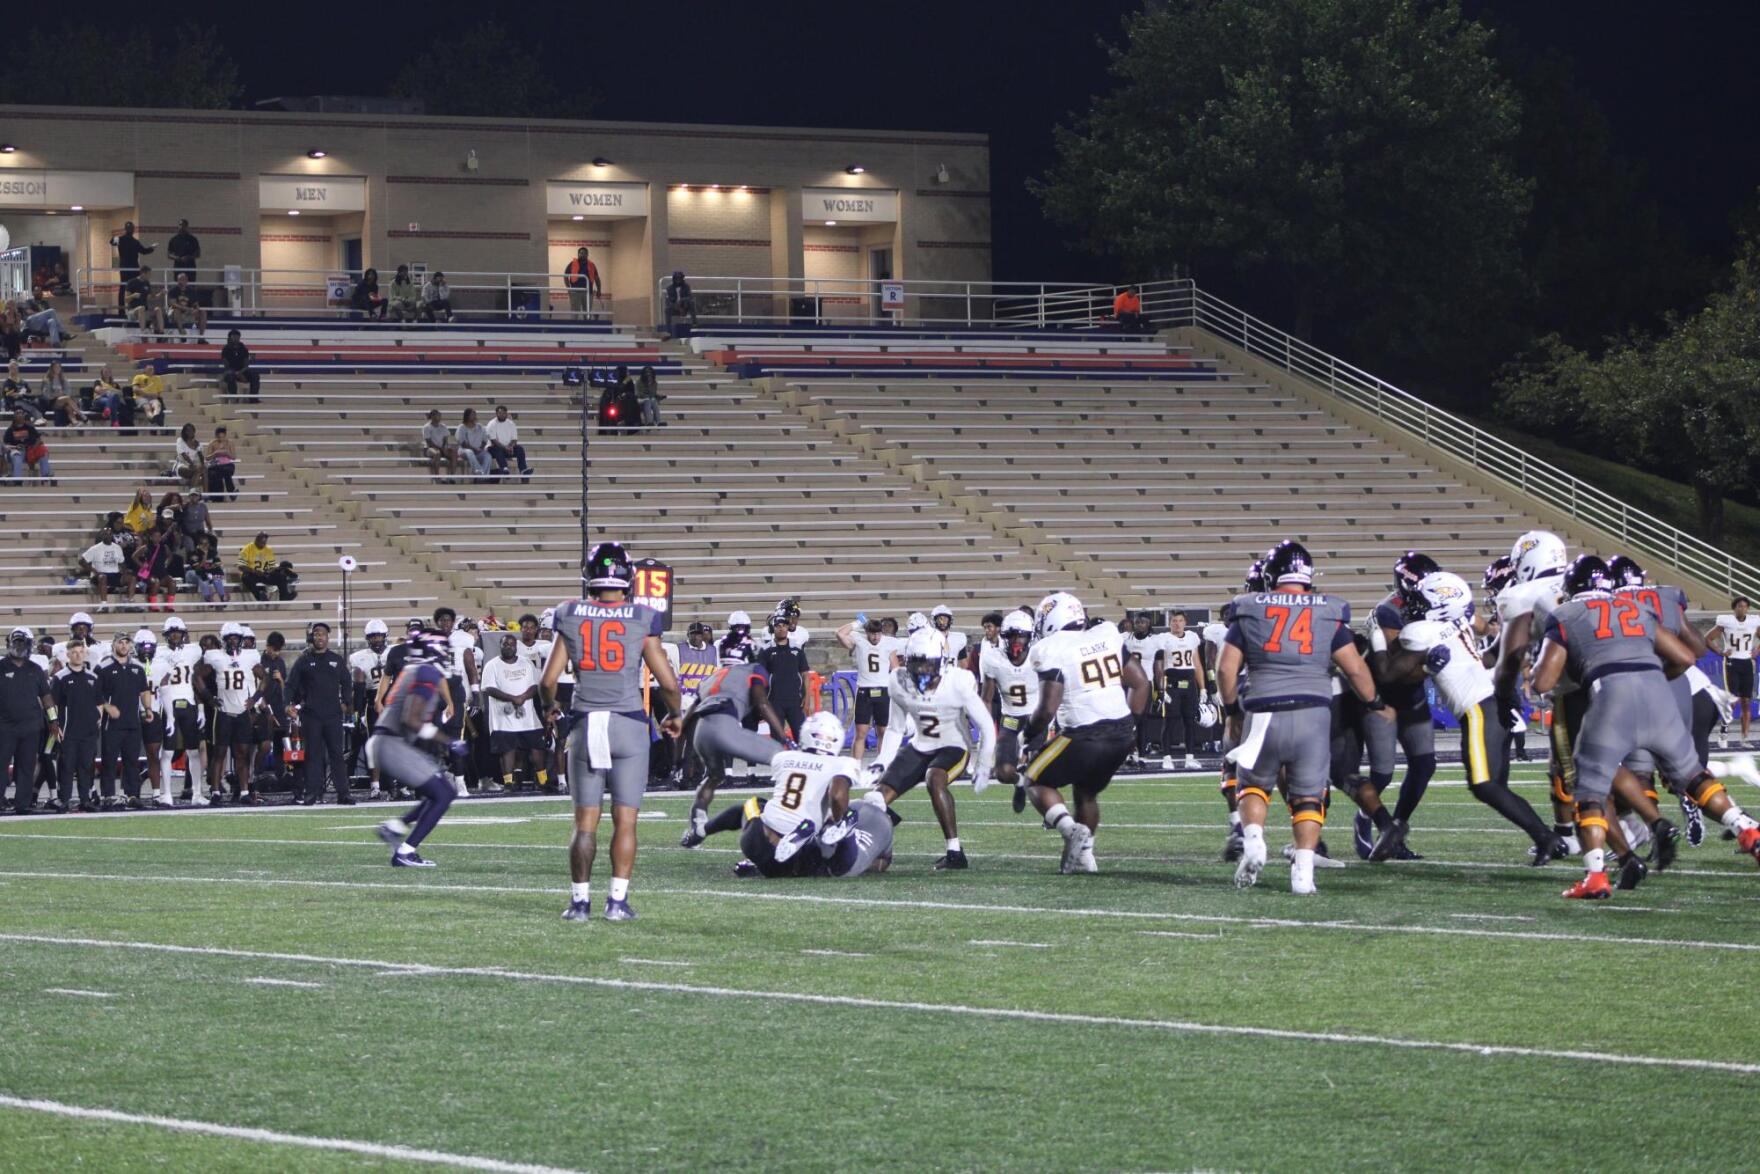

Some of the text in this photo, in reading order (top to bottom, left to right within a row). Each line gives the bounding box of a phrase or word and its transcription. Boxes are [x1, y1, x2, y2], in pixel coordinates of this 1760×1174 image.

[0, 181, 46, 195] SSION
[295, 187, 327, 200] MEN
[569, 192, 623, 207] WOMEN
[823, 199, 873, 212] WOMEN
[334, 287, 344, 297] Q
[890, 291, 897, 301] R
[635, 570, 667, 597] 15
[1255, 594, 1310, 605] CASILLAS
[574, 604, 634, 618] MUASAU
[1585, 600, 1646, 638] 72
[1263, 606, 1313, 654] 74
[579, 619, 626, 672] 16
[1080, 641, 1109, 657] CLARK
[1730, 633, 1752, 651] 47
[868, 653, 880, 673] 6
[1171, 650, 1193, 667] 30
[170, 665, 191, 685] 31
[1081, 653, 1124, 688] 99
[223, 670, 245, 690] 18
[1009, 685, 1027, 707] 9
[919, 714, 940, 738] 2
[291, 752, 299, 760] G
[783, 760, 823, 771] GRAHAM
[781, 772, 807, 810] 8
